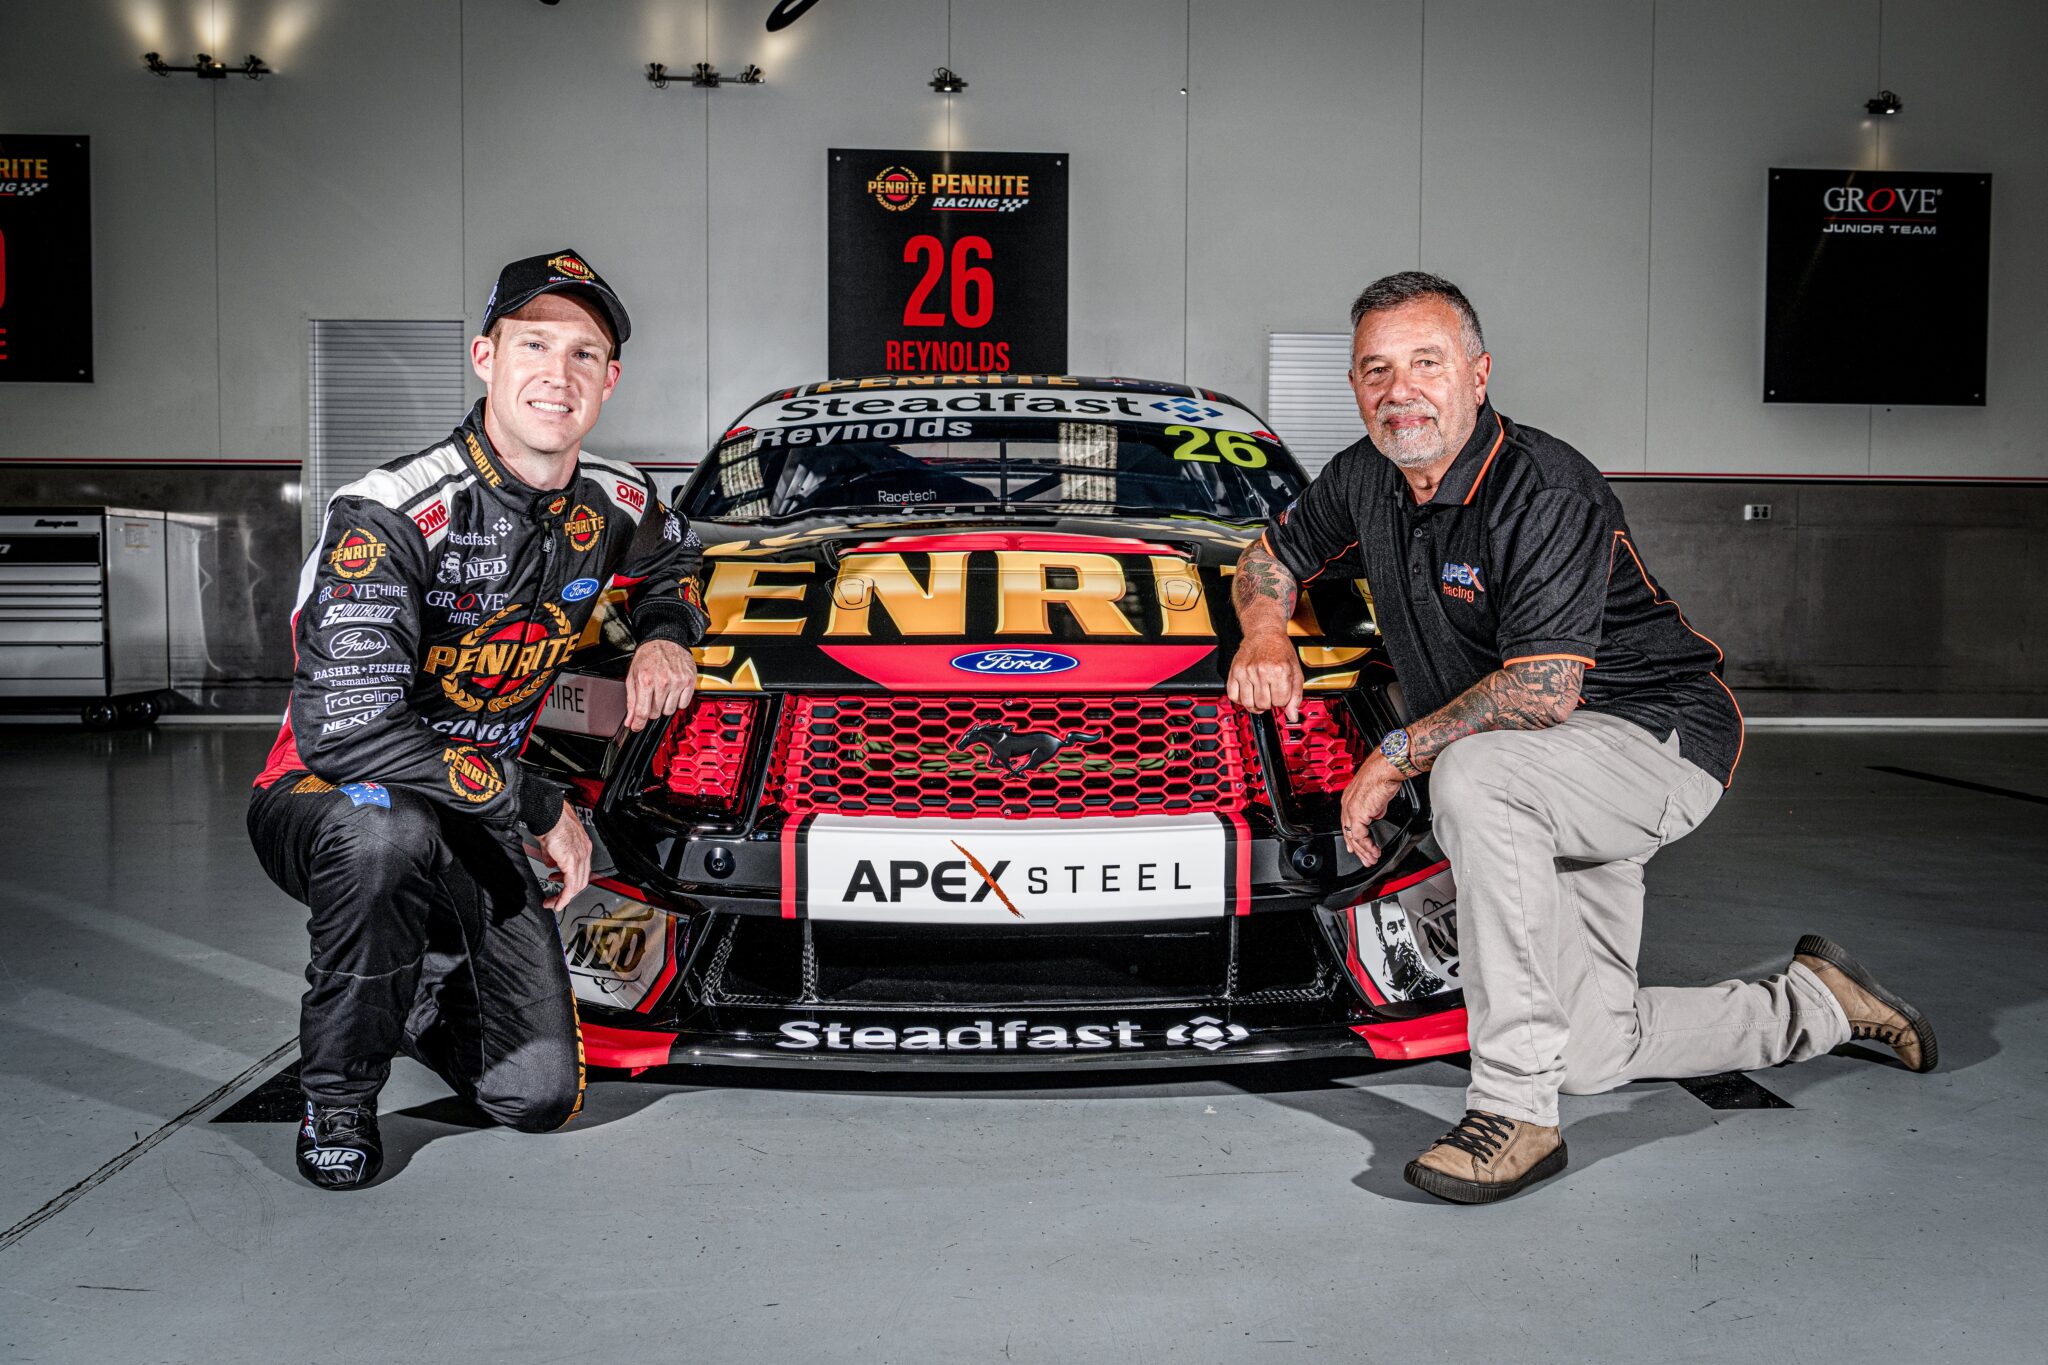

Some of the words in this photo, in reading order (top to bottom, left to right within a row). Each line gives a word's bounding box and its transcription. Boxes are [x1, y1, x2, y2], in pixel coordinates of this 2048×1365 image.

[0, 159, 48, 178] RITE
[867, 180, 927, 195] PENRITE
[931, 174, 1030, 196] PENRITE
[932, 197, 1000, 209] RACING
[1823, 224, 1884, 234] JUNIOR
[1890, 225, 1937, 235] TEAM
[903, 234, 995, 329] 26
[886, 340, 1011, 372] REYNOLDS
[777, 392, 1142, 422] Steadfast
[752, 418, 972, 449] Reynolds
[1164, 425, 1268, 469] 26
[466, 431, 502, 488] PENRITE
[617, 485, 645, 507] OMP
[878, 489, 937, 503] Racetech
[417, 504, 447, 535] OMP
[448, 531, 498, 546] teadfast
[329, 543, 387, 565] PENRITE
[466, 560, 508, 578] NED
[1442, 563, 1483, 589] APEX
[380, 585, 408, 597] HIRE
[570, 582, 592, 598] Ford
[704, 550, 1325, 636] ENRI
[1443, 583, 1475, 603] Racing
[448, 612, 480, 626] HIRE
[333, 632, 384, 658] Gates
[422, 633, 581, 678] PENRITE
[314, 665, 361, 681] DASHER
[369, 664, 411, 674] FISHER
[976, 653, 1053, 670] Ford
[330, 676, 380, 687] Tasmanian
[331, 690, 399, 709] raceline
[421, 716, 505, 741] CING
[443, 747, 505, 792] PENRITE
[842, 847, 1020, 914] APEX
[1027, 862, 1192, 895] STEEL
[565, 923, 646, 973] NED
[776, 1019, 1145, 1050] Steadfast
